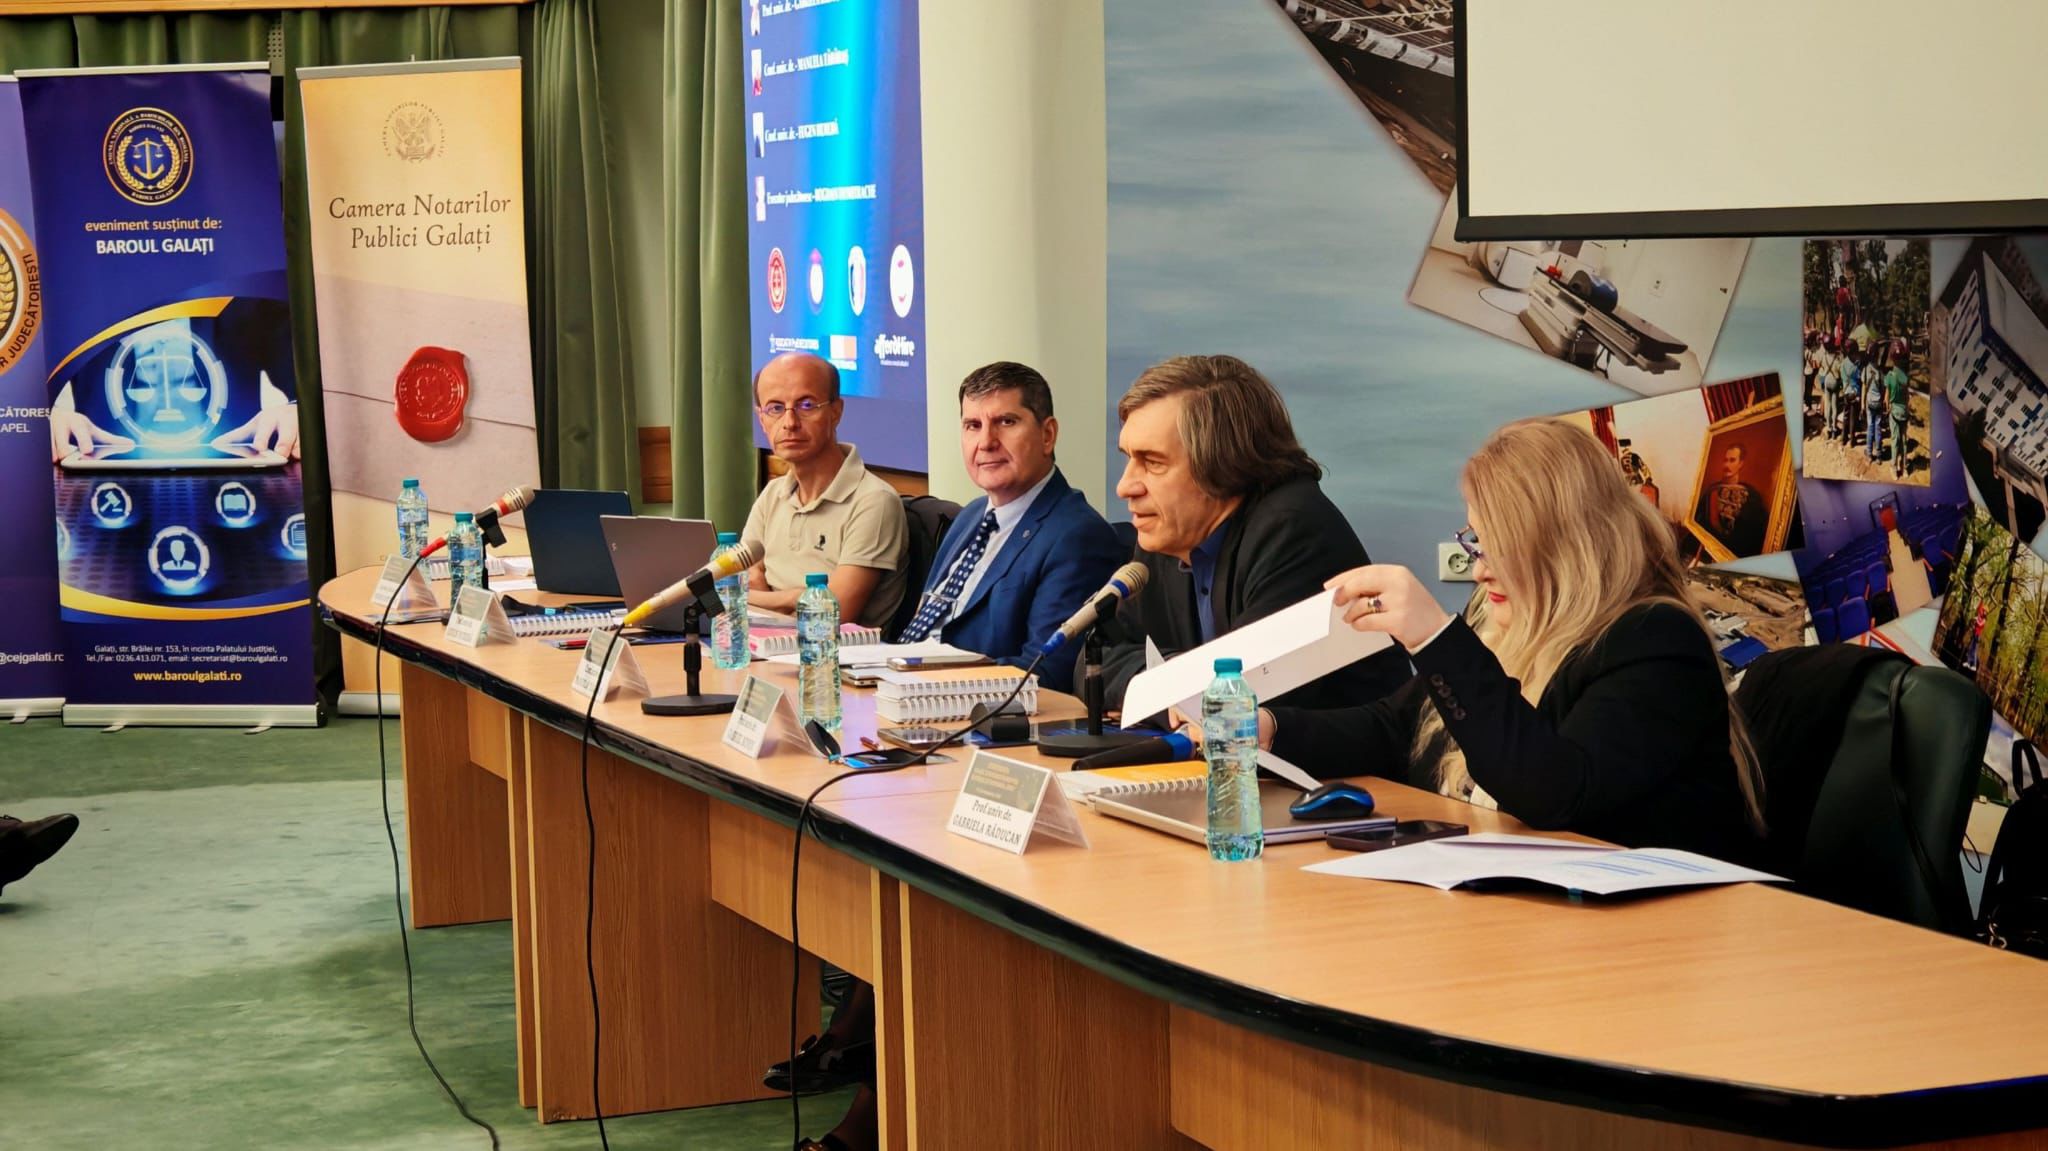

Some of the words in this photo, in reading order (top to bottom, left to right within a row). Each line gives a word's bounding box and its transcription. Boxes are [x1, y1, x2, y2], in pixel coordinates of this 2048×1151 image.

[329, 197, 406, 219] Camera
[413, 190, 512, 216] Notarilor
[85, 219, 150, 232] eveniment
[202, 216, 223, 230] de:
[351, 225, 418, 249] Publici
[425, 222, 492, 252] Galați
[96, 239, 160, 255] BAROUL
[165, 645, 181, 654] 153,
[215, 645, 247, 653] Palatului
[115, 655, 167, 664] 0236.413.071,
[191, 655, 288, 664] secretariat@baroulgalati.ro
[134, 671, 242, 683] www.baroulgalati.ro
